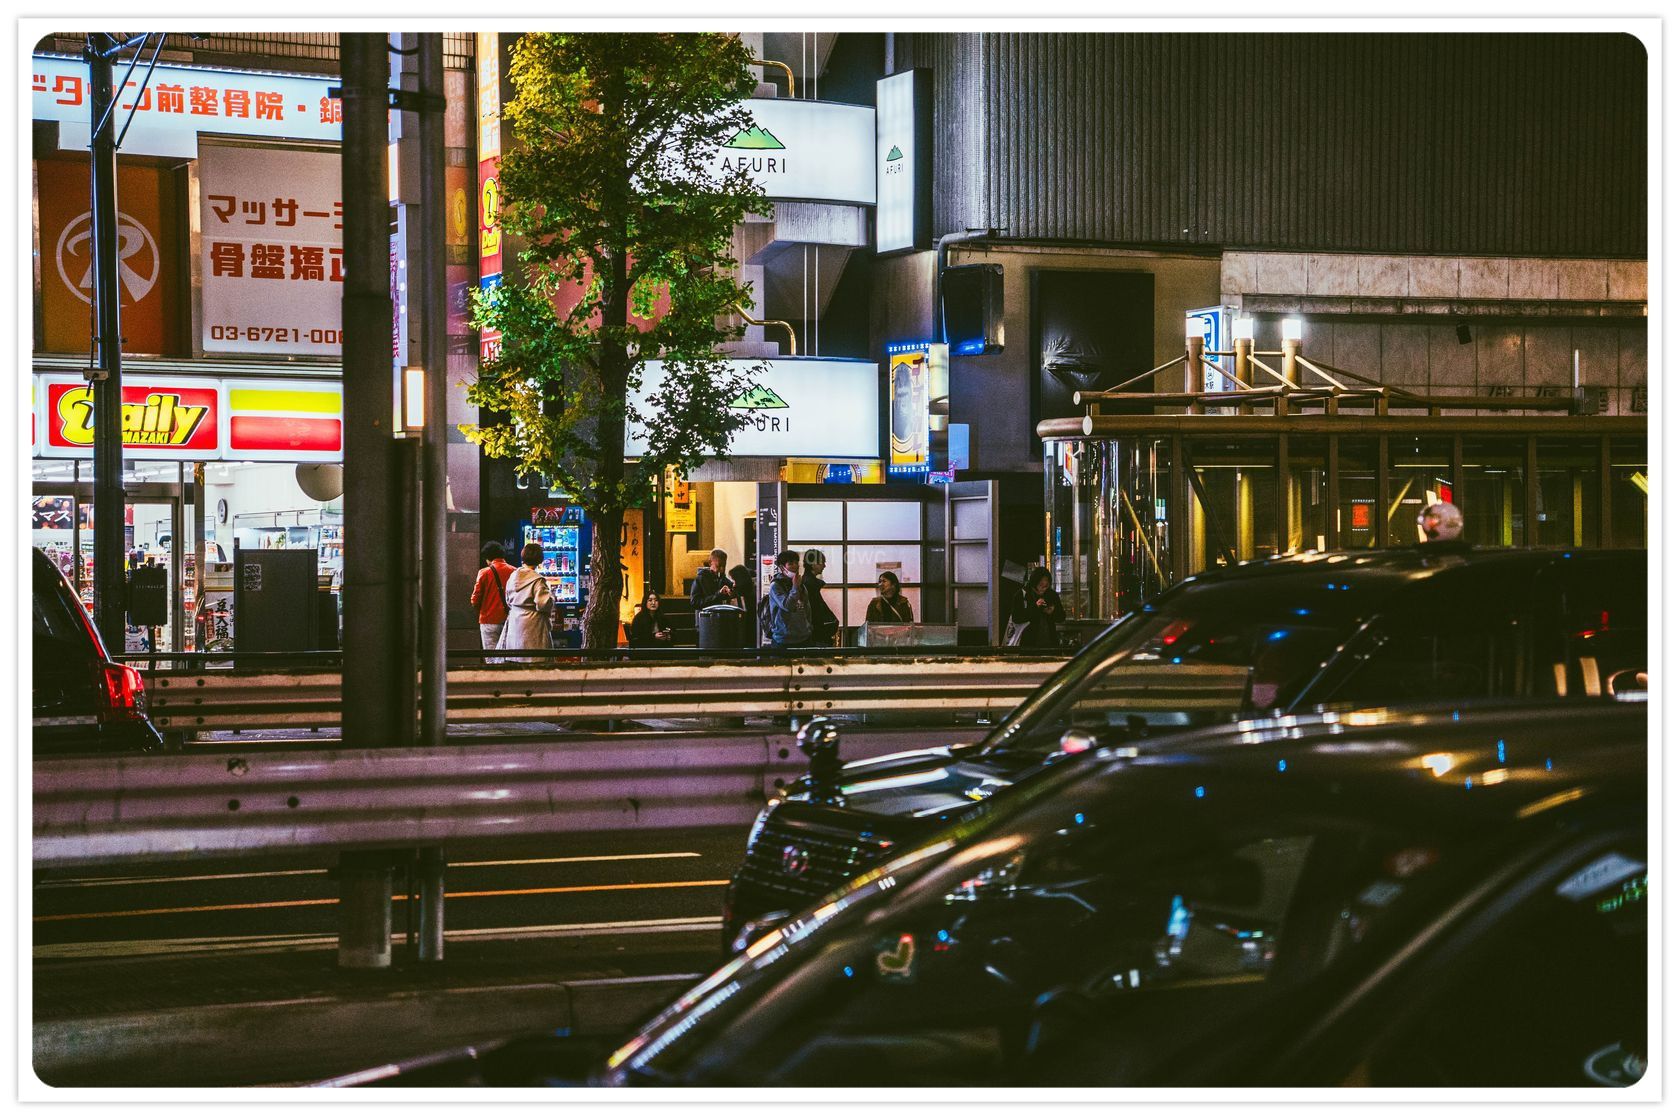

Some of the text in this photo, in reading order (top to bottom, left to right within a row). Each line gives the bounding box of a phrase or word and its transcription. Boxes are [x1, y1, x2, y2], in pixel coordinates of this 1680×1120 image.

[721, 157, 786, 173] AFURI
[58, 387, 207, 445] Daily
[122, 431, 171, 444] MAZAKI
